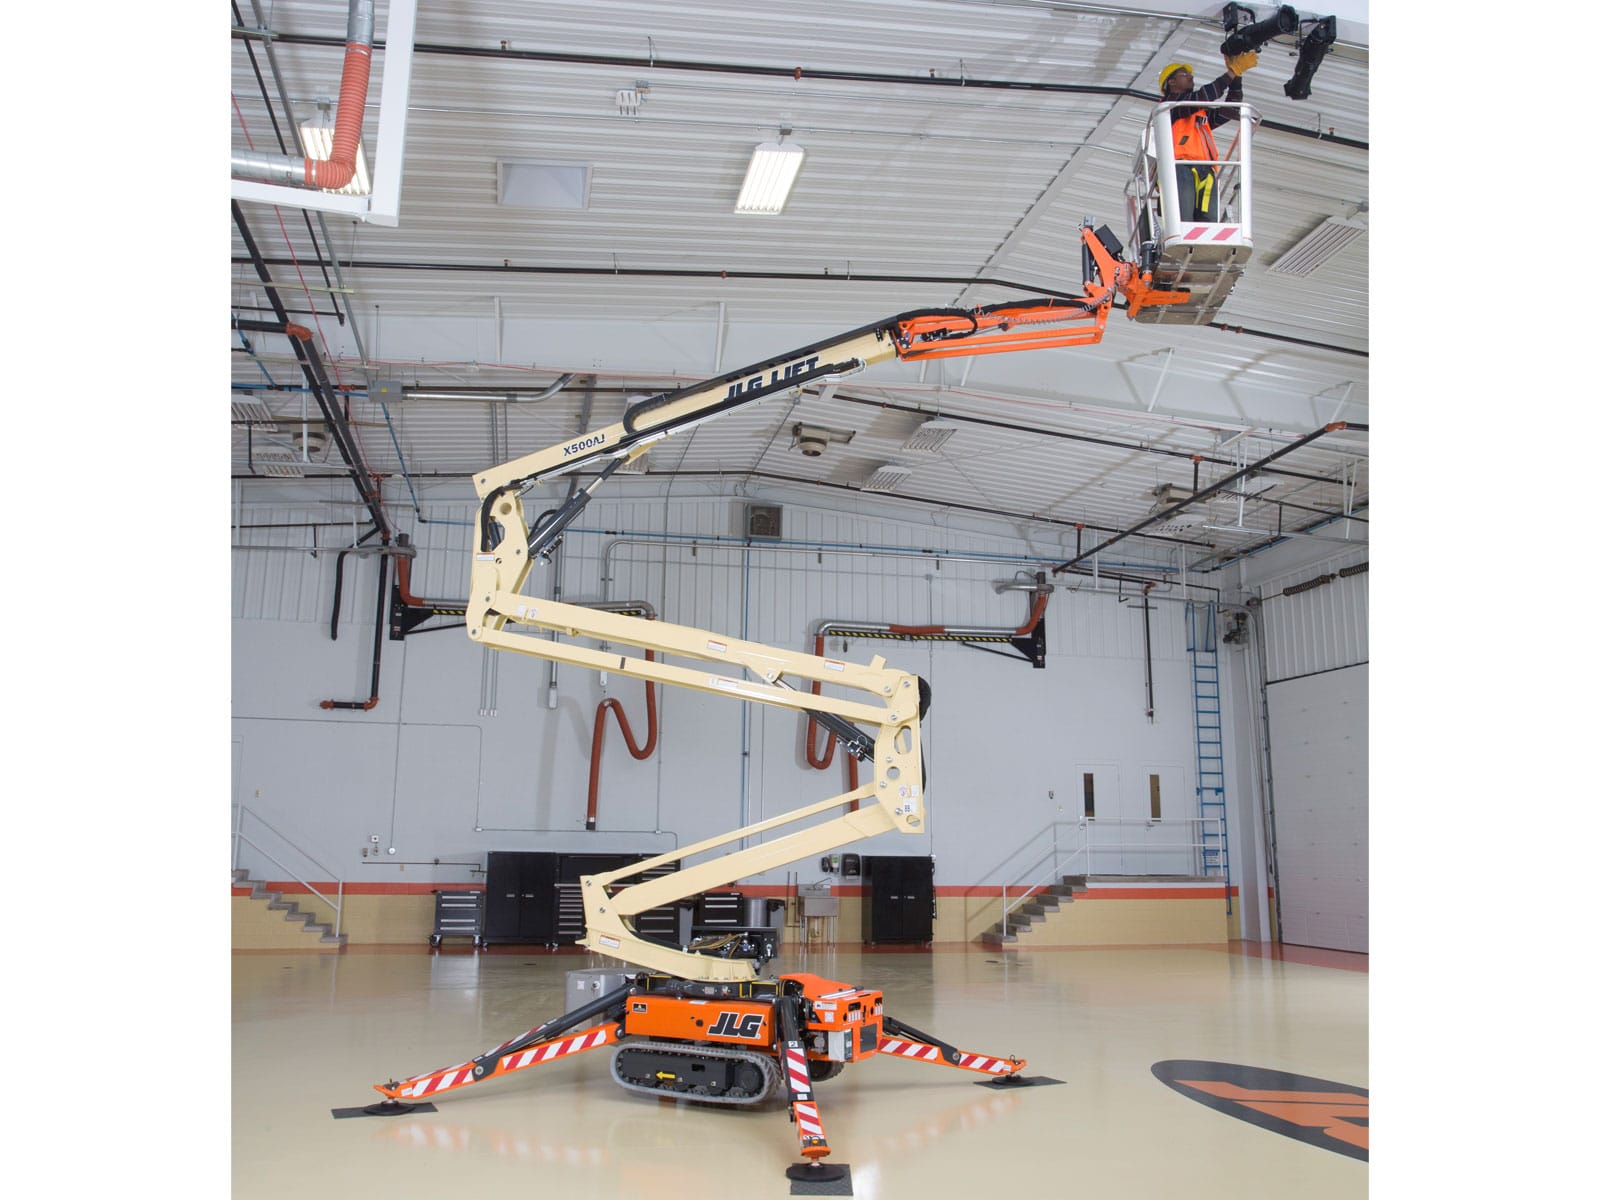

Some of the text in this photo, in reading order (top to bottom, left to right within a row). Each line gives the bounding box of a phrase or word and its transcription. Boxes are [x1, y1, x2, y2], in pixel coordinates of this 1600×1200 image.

[771, 356, 819, 385] LIFT
[563, 433, 605, 456] X500AJ
[706, 1012, 763, 1038] JLG
